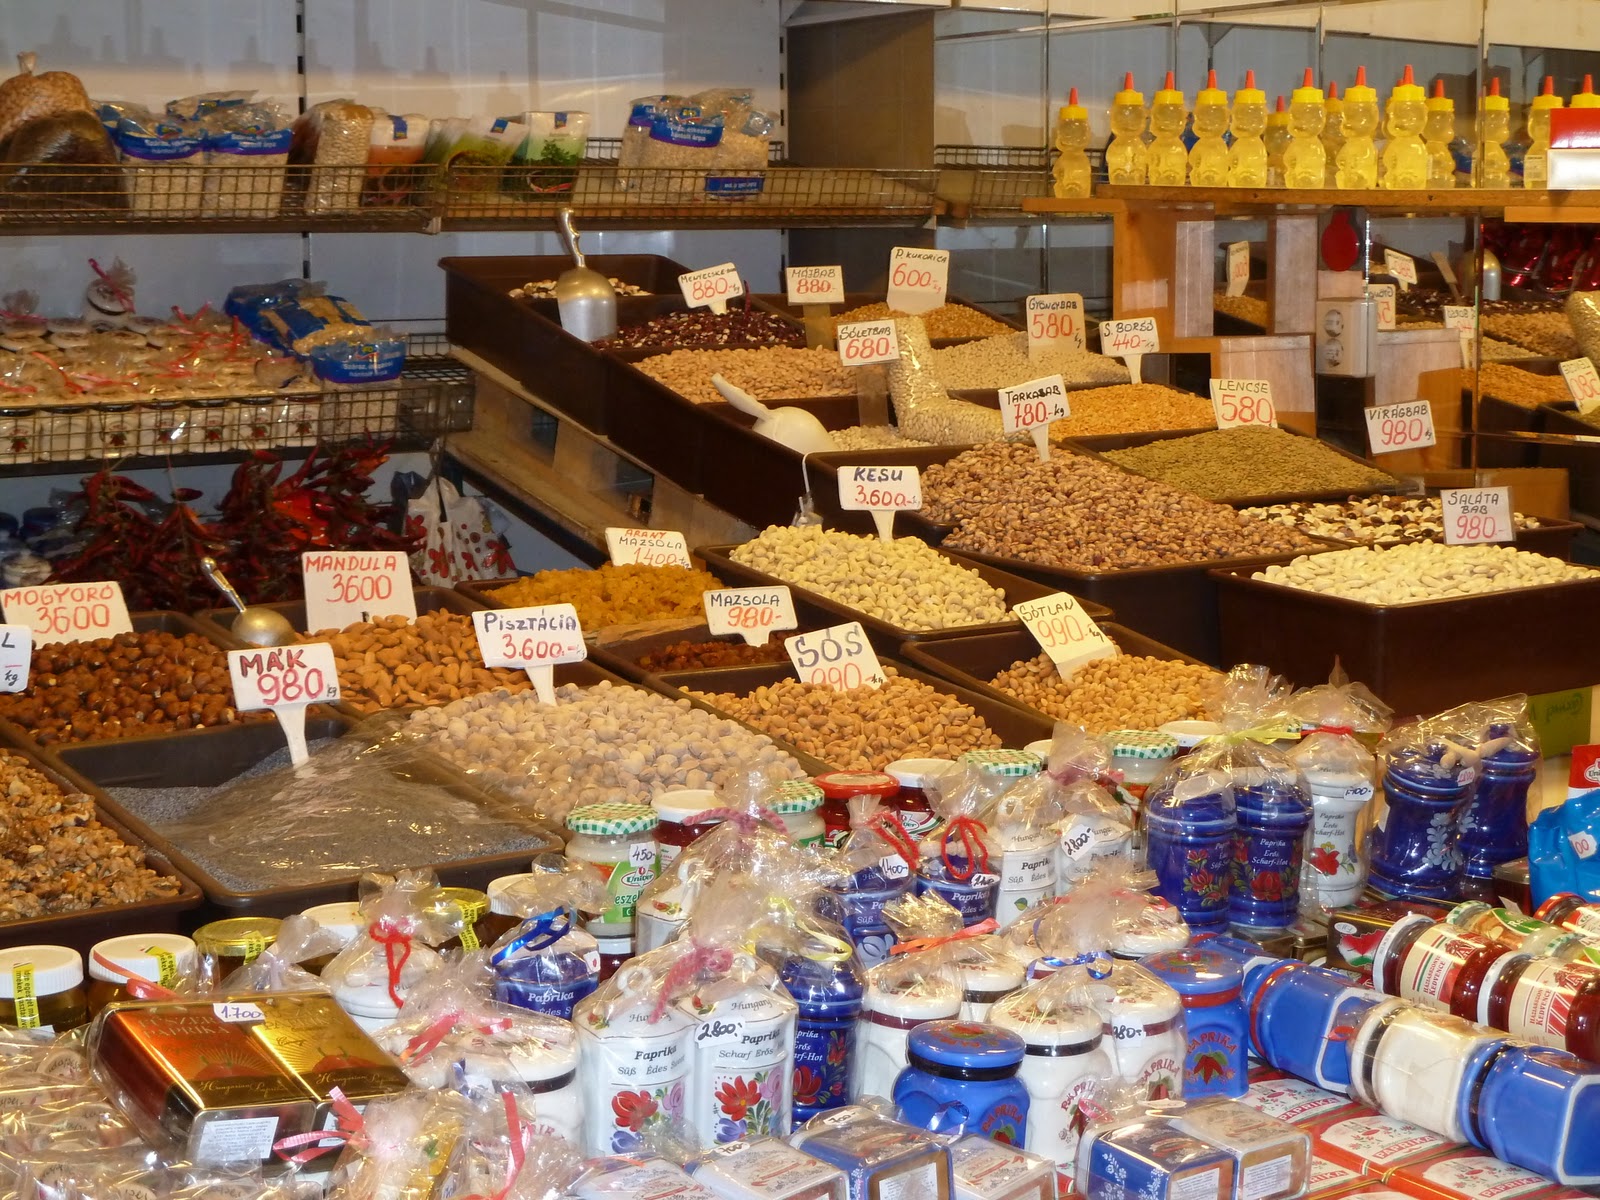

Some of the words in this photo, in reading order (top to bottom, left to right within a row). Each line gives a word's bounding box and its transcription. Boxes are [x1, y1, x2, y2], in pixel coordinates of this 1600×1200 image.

[1005, 385, 1062, 405] TARKABAB
[1219, 380, 1268, 394] LENCSE
[1381, 418, 1423, 446] 980
[853, 466, 903, 483] KESU
[1448, 491, 1499, 506] SALÁTA
[1461, 505, 1488, 515] BAB
[624, 529, 667, 539] ARANY
[619, 537, 682, 550] MAZSOLA
[305, 555, 397, 573] MANDULA
[326, 574, 392, 603] 3600
[710, 593, 780, 607] MAZSOLA
[33, 603, 110, 635] 3600
[1020, 599, 1074, 622] SÓTLAN
[239, 648, 307, 678] MÁK
[4, 669, 19, 687] kg
[257, 668, 324, 705] 980
[1021, 858, 1051, 871] Paprik
[1008, 876, 1024, 884] Süß
[1031, 873, 1046, 882] Édes
[857, 915, 874, 924] Süß
[1429, 960, 1446, 996] KEDVENCE
[528, 991, 575, 1005] Paprika
[731, 998, 773, 1011] Hungary
[796, 1030, 819, 1039] prika
[1186, 1031, 1239, 1055] PAPRIKA
[719, 1050, 752, 1060] Scharf
[618, 1066, 637, 1076] Süß
[646, 1065, 668, 1075] Édes
[981, 1103, 1023, 1132] PAPRIKA
[1279, 1097, 1339, 1122] PAPRIKA
[1377, 1135, 1435, 1159] PAPRIKA
[1310, 1170, 1348, 1184] RIKA
[1482, 1177, 1544, 1198] PAPRIKA
